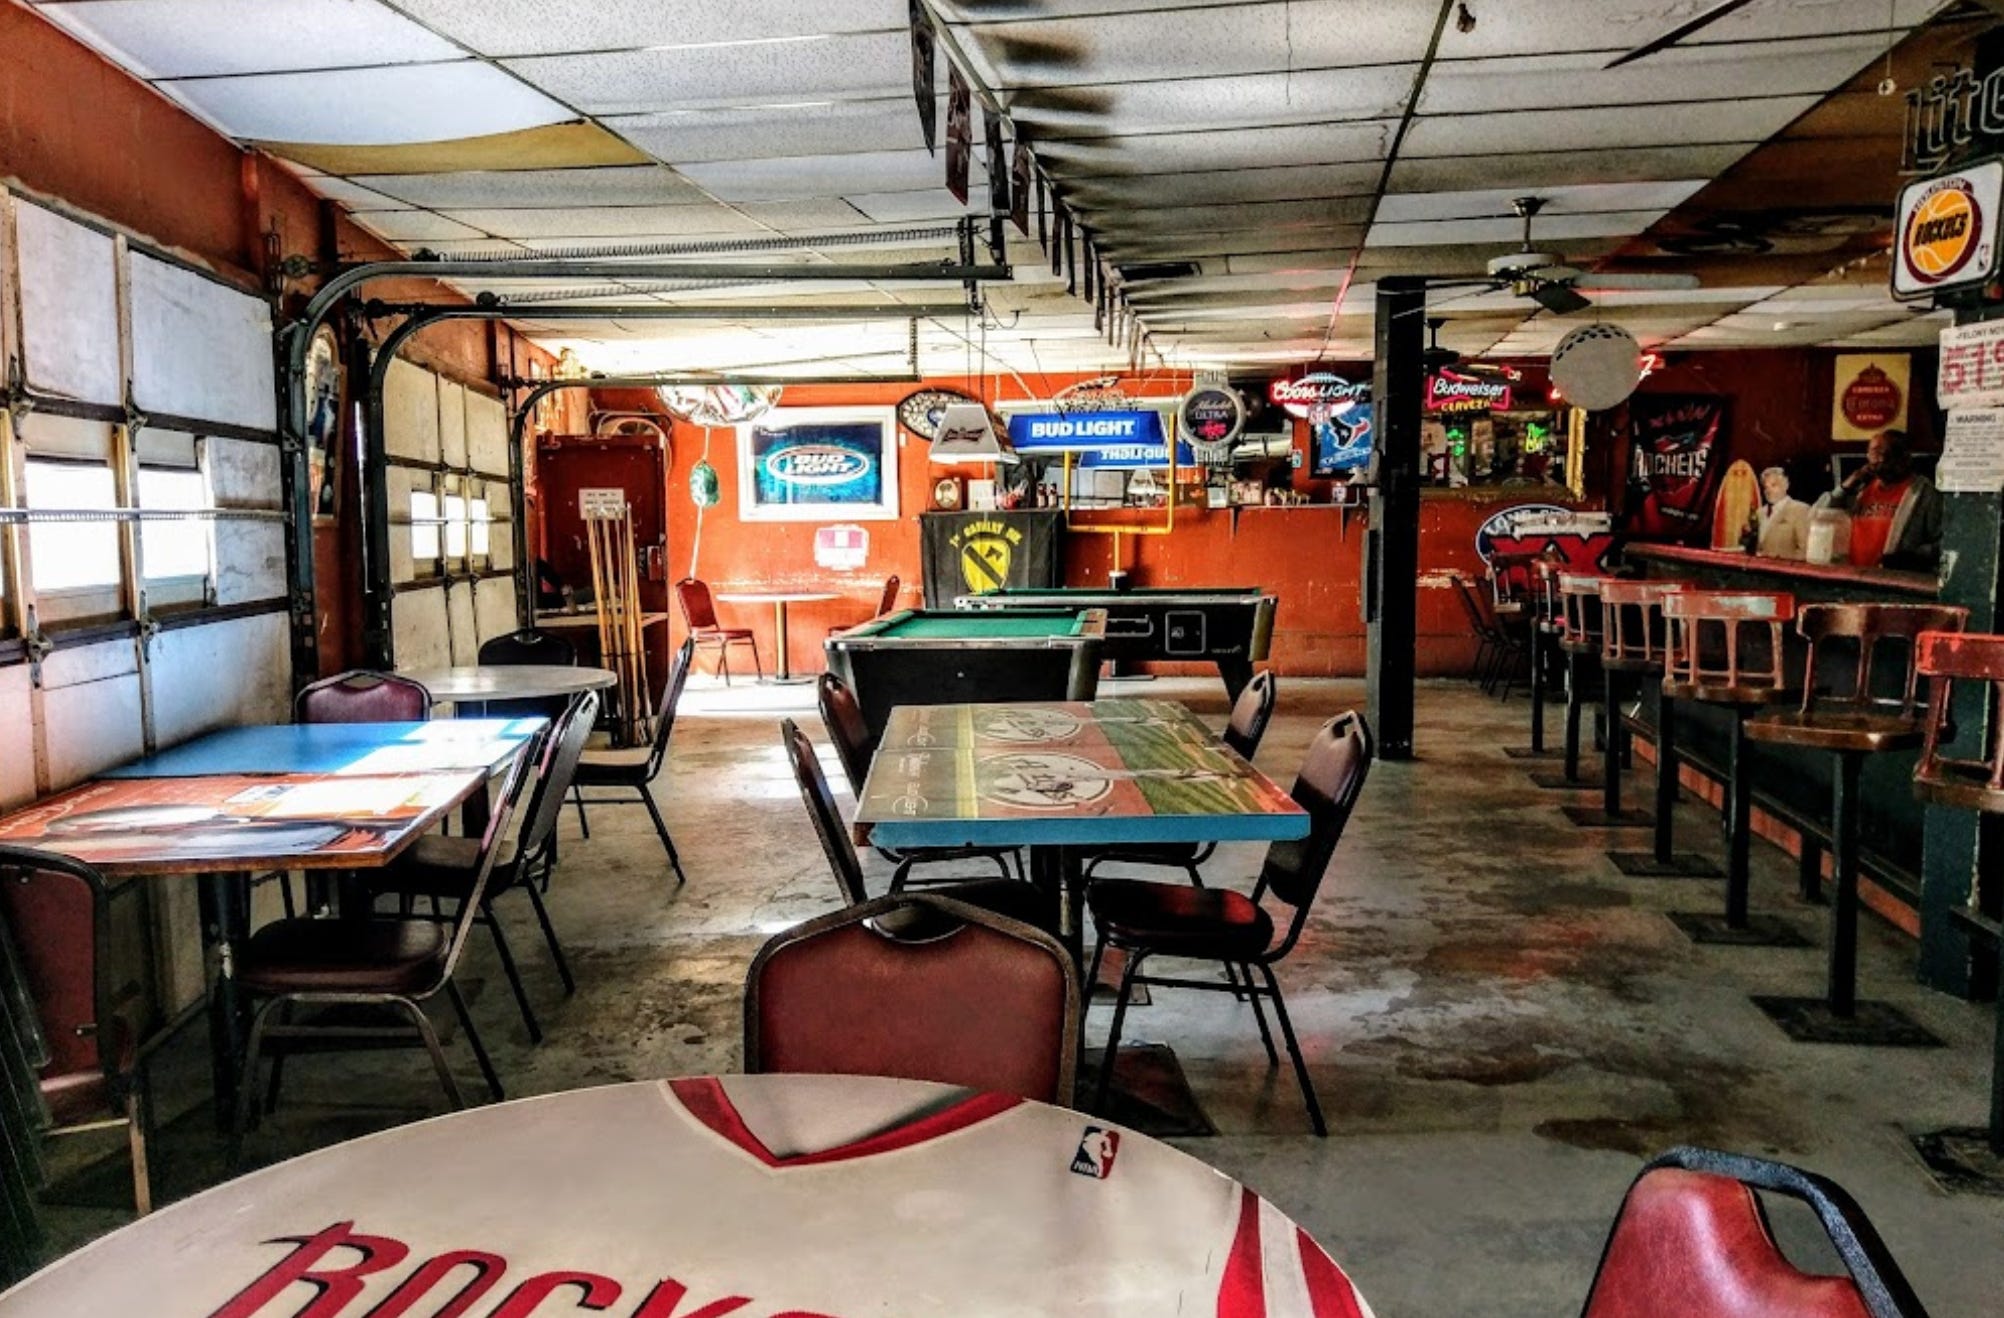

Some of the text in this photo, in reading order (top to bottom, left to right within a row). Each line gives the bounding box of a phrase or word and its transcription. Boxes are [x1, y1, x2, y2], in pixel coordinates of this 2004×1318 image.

[1912, 213, 1969, 247] ROCKETS
[1273, 380, 1368, 399] Coors LIGHT
[1433, 379, 1505, 396] Budweiser
[1441, 397, 1491, 412] CERVEZA
[1195, 411, 1229, 420] ULTRA
[1956, 413, 1996, 423] WARNING
[1031, 420, 1136, 438] BUD LIGHT
[793, 454, 846, 465] BUD
[784, 462, 855, 475] LIGHT
[1074, 1160, 1098, 1174] NBA
